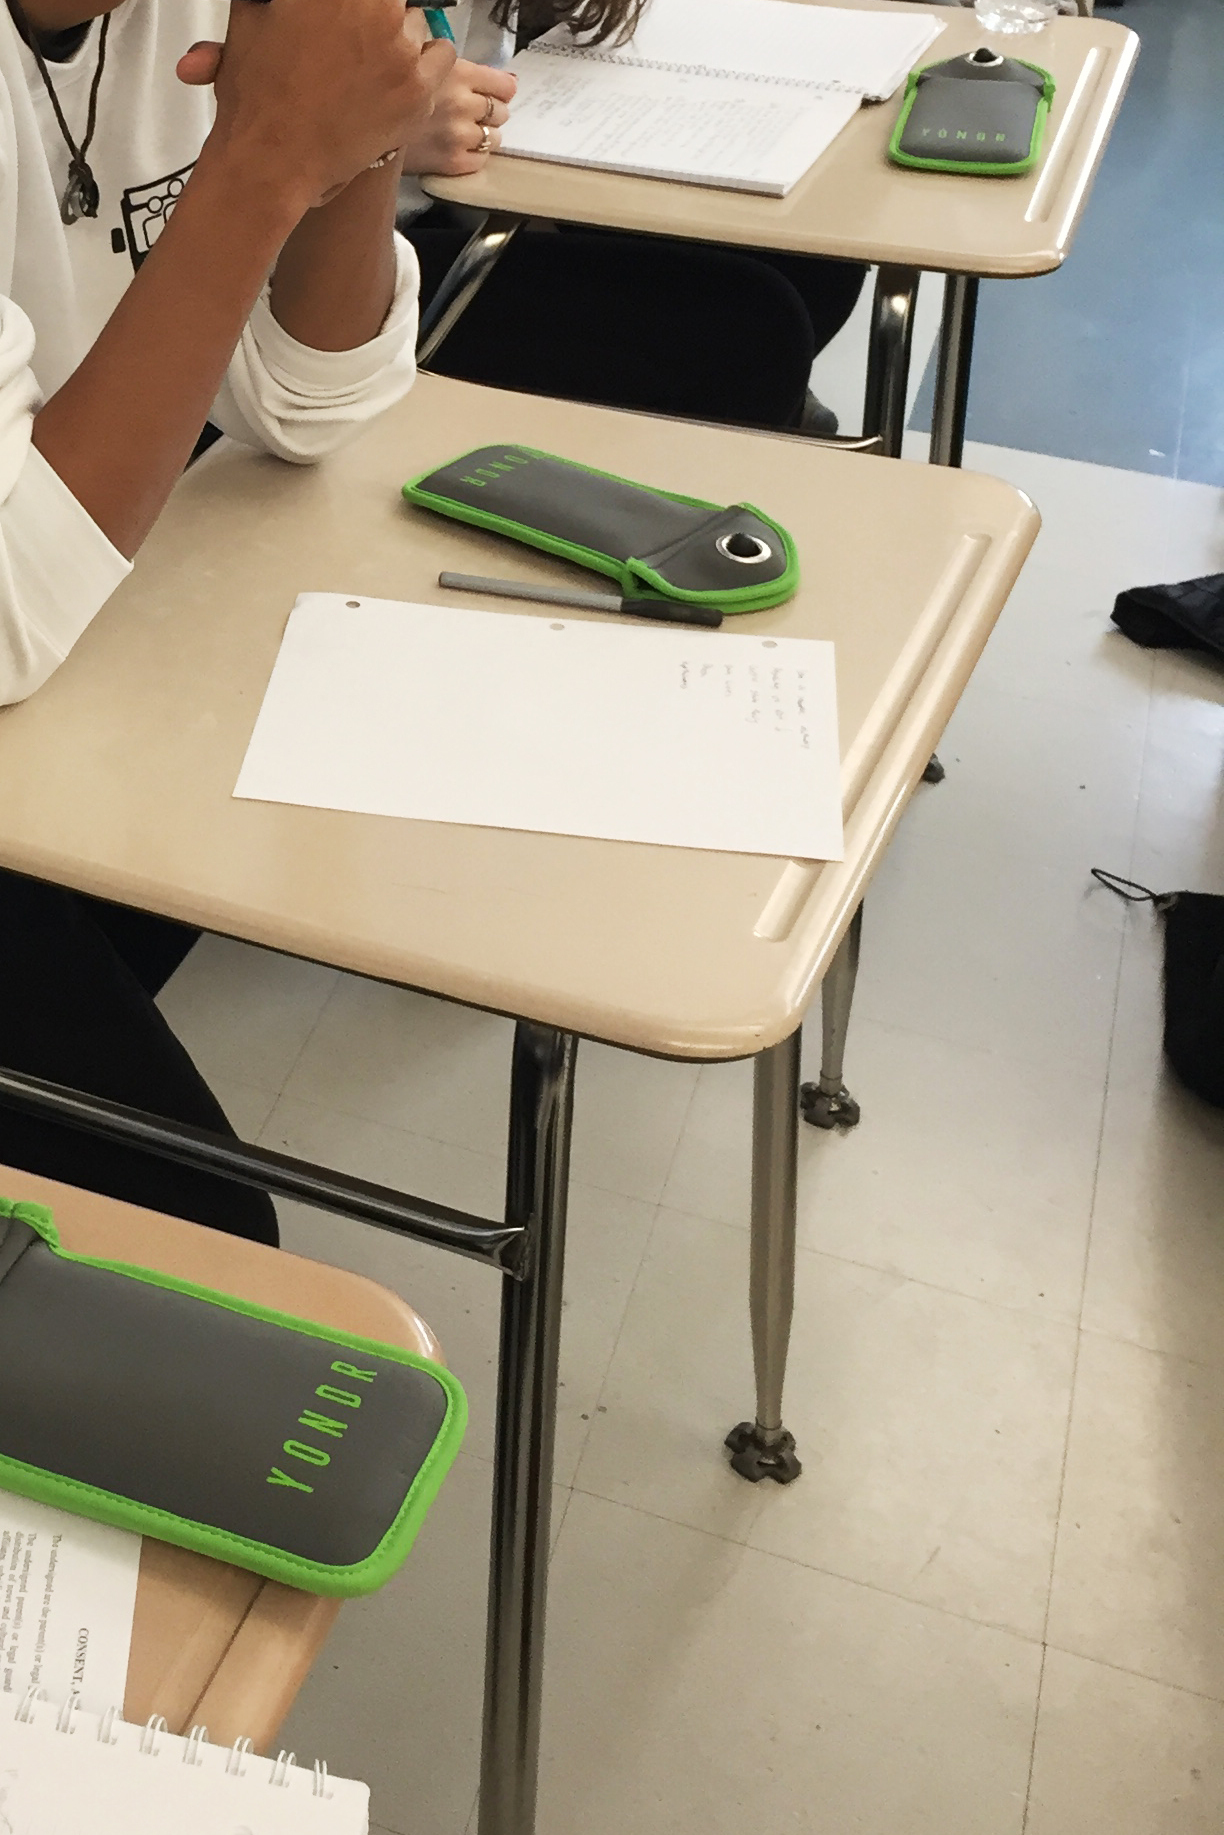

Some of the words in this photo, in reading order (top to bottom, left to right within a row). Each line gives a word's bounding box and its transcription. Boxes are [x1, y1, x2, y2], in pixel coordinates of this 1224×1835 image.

[459, 454, 529, 488] ONDR
[266, 1360, 378, 1494] YONDR
[17, 1549, 34, 1592] undersigned
[42, 1549, 59, 1592] undersigned
[6, 1645, 20, 1664] legal
[29, 1664, 44, 1684] legal
[68, 1626, 88, 1686] CONSENT,
